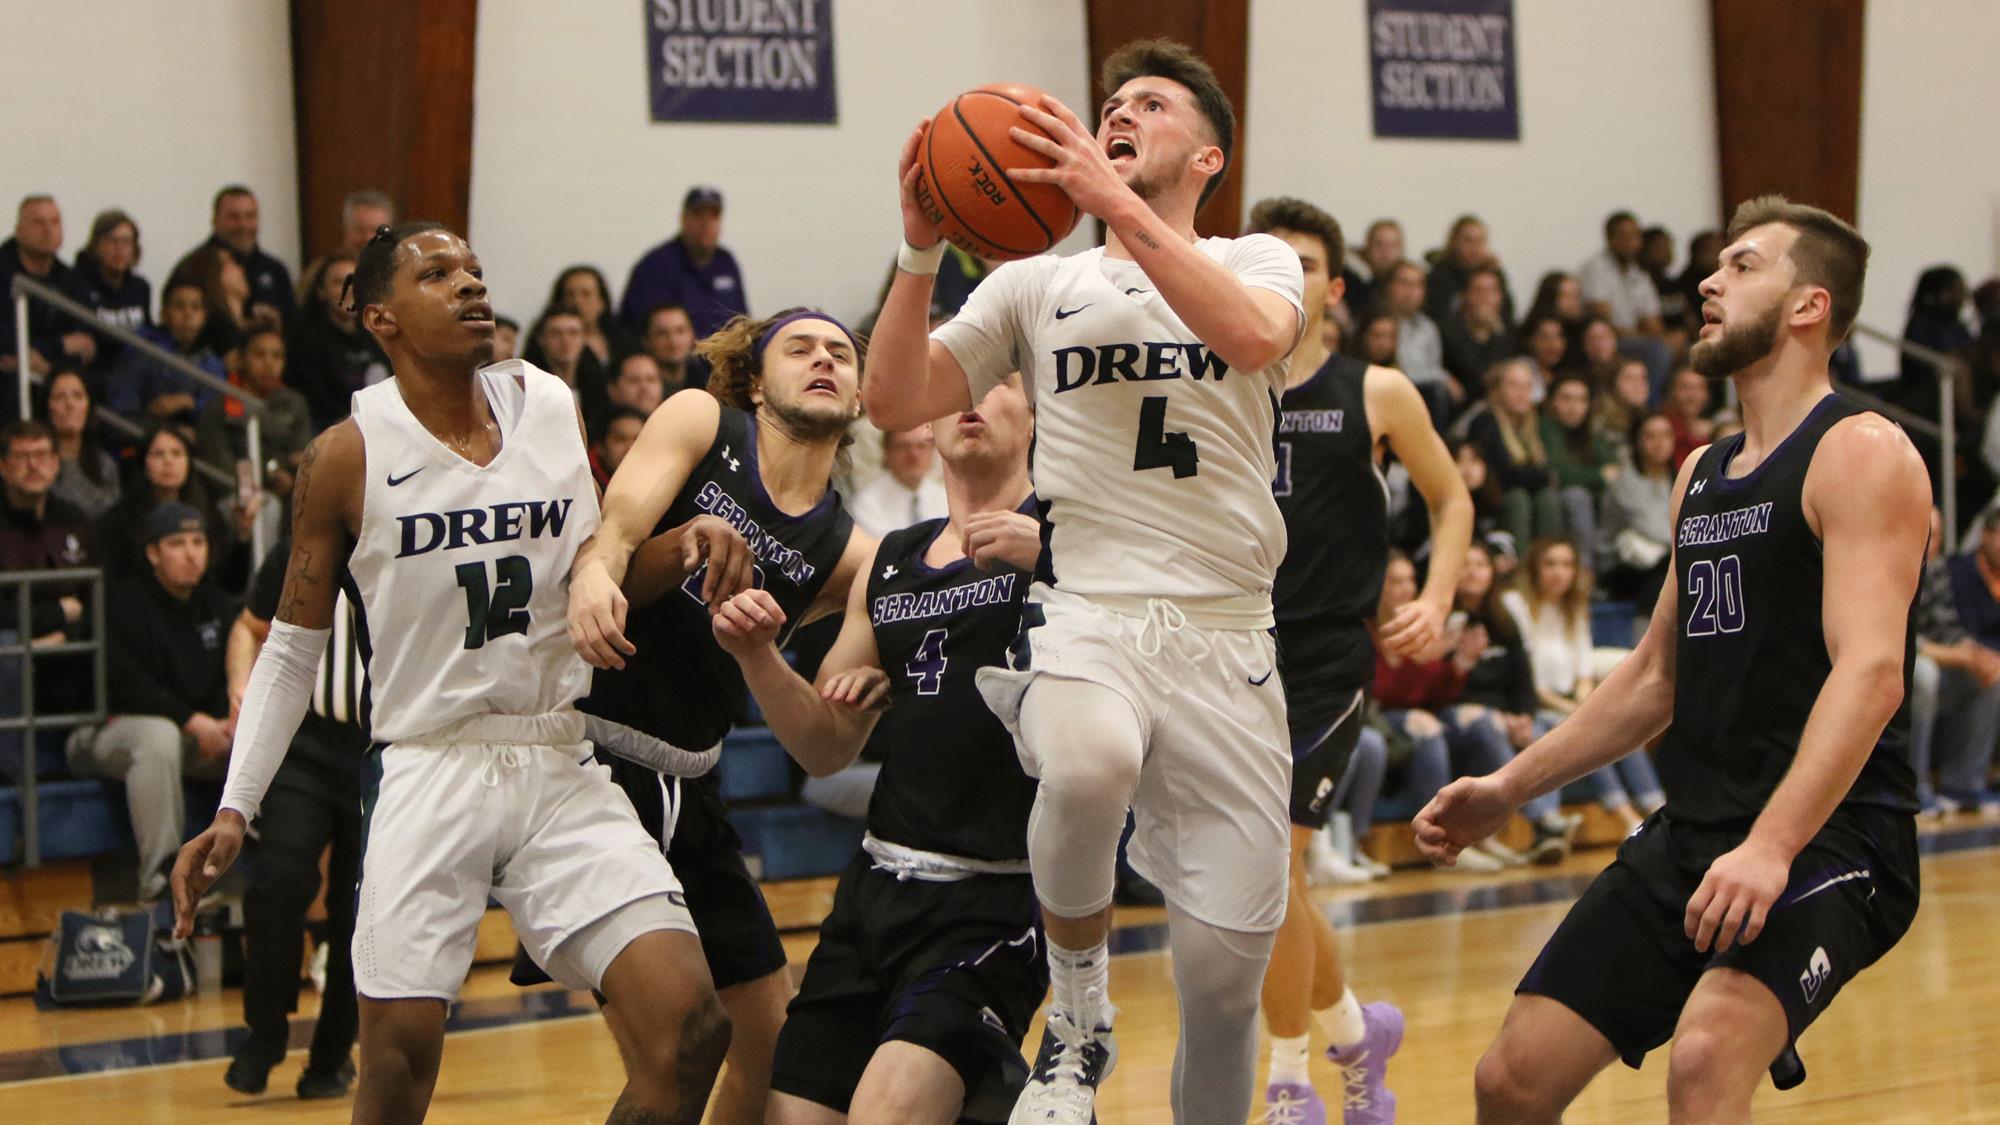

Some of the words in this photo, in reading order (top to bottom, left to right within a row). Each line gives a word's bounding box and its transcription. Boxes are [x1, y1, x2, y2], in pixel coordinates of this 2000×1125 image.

[653, 0, 816, 32] STUDENT
[1374, 10, 1506, 61] STUDENT
[661, 34, 818, 89] SECTION
[1380, 61, 1506, 110] SECTION
[968, 160, 1007, 206] ROCK
[1052, 341, 1229, 394] DREW
[1133, 396, 1200, 479] 4
[395, 499, 574, 559] DREW
[694, 481, 815, 587] SCRANTON
[1678, 501, 1774, 548] SCRANTON
[455, 555, 533, 649] 12
[873, 574, 1016, 626] SCRANTON
[1687, 554, 1746, 637] 20
[906, 628, 949, 695] 4
